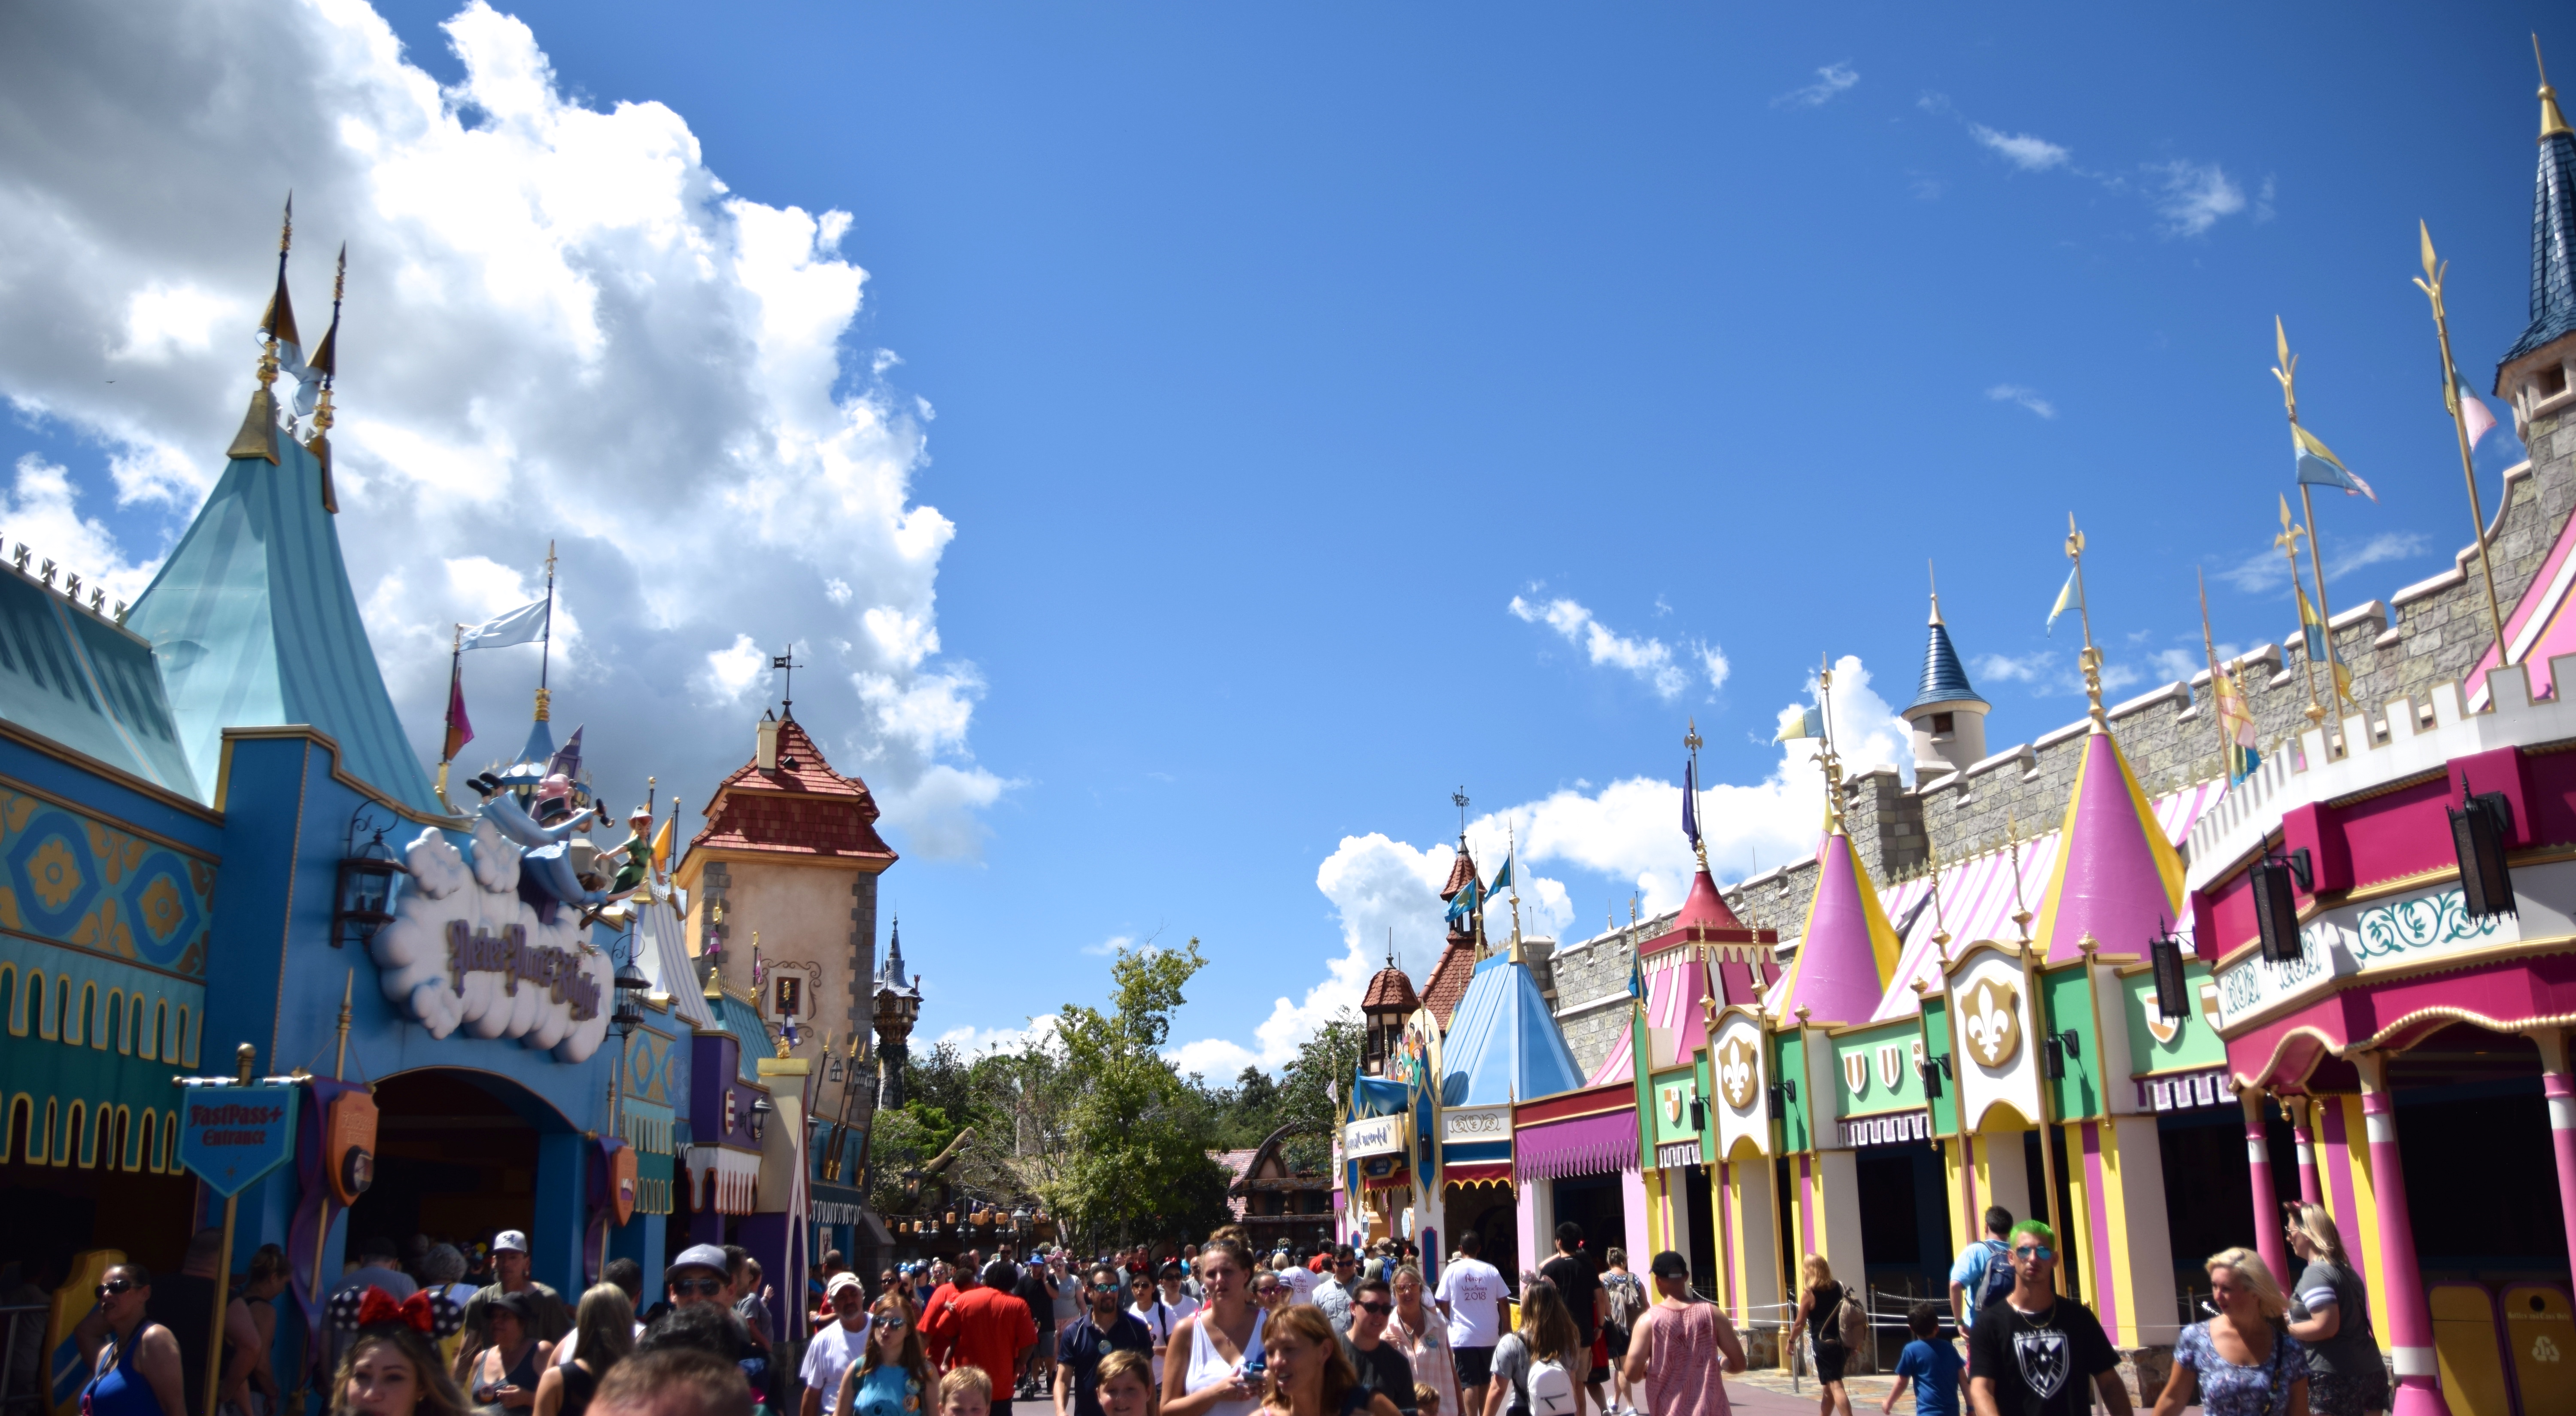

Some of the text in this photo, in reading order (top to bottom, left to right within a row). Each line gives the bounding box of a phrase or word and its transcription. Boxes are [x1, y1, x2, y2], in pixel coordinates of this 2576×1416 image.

[448, 919, 508, 999] Peter
[504, 924, 554, 997] Pan's
[202, 1129, 266, 1146] Entrance
[1464, 1291, 1486, 1301] 2018
